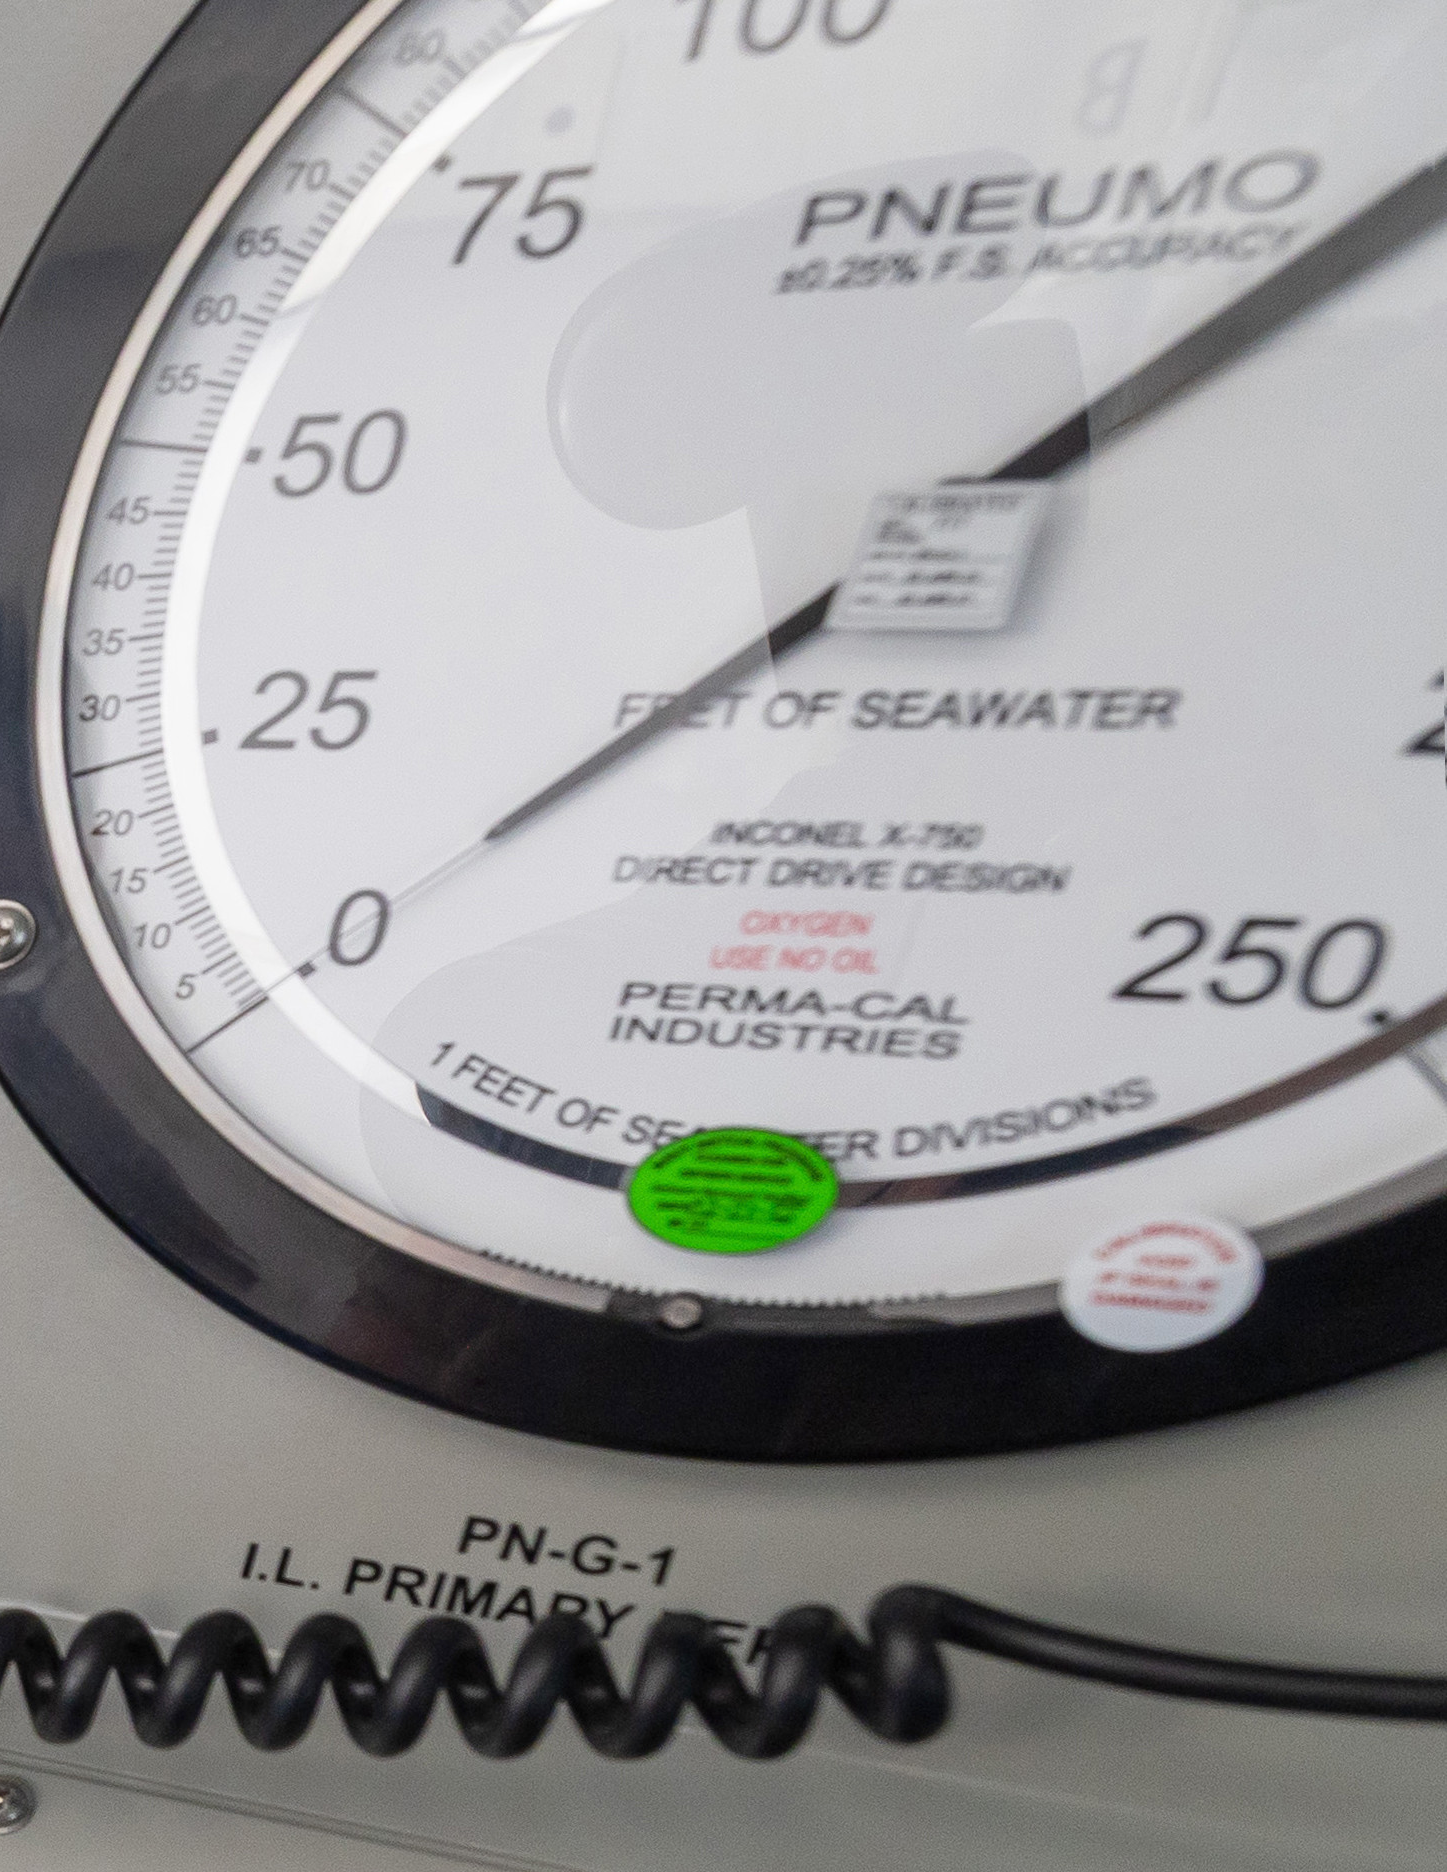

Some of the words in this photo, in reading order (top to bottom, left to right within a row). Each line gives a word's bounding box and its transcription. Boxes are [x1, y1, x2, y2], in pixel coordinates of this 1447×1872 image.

[451, 164, 598, 267] 75
[791, 149, 1323, 249] PNEUMO
[236, 227, 281, 259] 65
[1025, 222, 1311, 275] ACCURACY
[160, 365, 201, 395] 55
[271, 408, 408, 499] 50
[108, 498, 150, 526] 45
[92, 562, 134, 591] 40
[83, 628, 124, 656] 35
[79, 694, 120, 722] 30
[238, 670, 378, 750] 25
[762, 690, 843, 729] OF
[850, 687, 1180, 730] SEAWATER
[91, 809, 133, 837] 20
[110, 867, 149, 894] 15
[612, 855, 759, 887] DIRECT
[764, 857, 897, 891] DRIVE
[900, 861, 1074, 895] DESIGN
[134, 922, 172, 949] 10
[329, 889, 391, 967] 0
[738, 909, 875, 937] OXYGEN
[1112, 911, 1390, 1012] 250
[175, 973, 196, 998] 5
[617, 981, 973, 1025] PERMA-CAL
[608, 1016, 962, 1060] INDUSTRIES
[429, 1042, 455, 1067] 1
[451, 1054, 558, 1115] FEET
[558, 1097, 619, 1133] OF
[894, 1076, 1158, 1160] DIVISIONS
[240, 1543, 321, 1590] I.L.
[458, 1516, 677, 1588] PN-G-1
